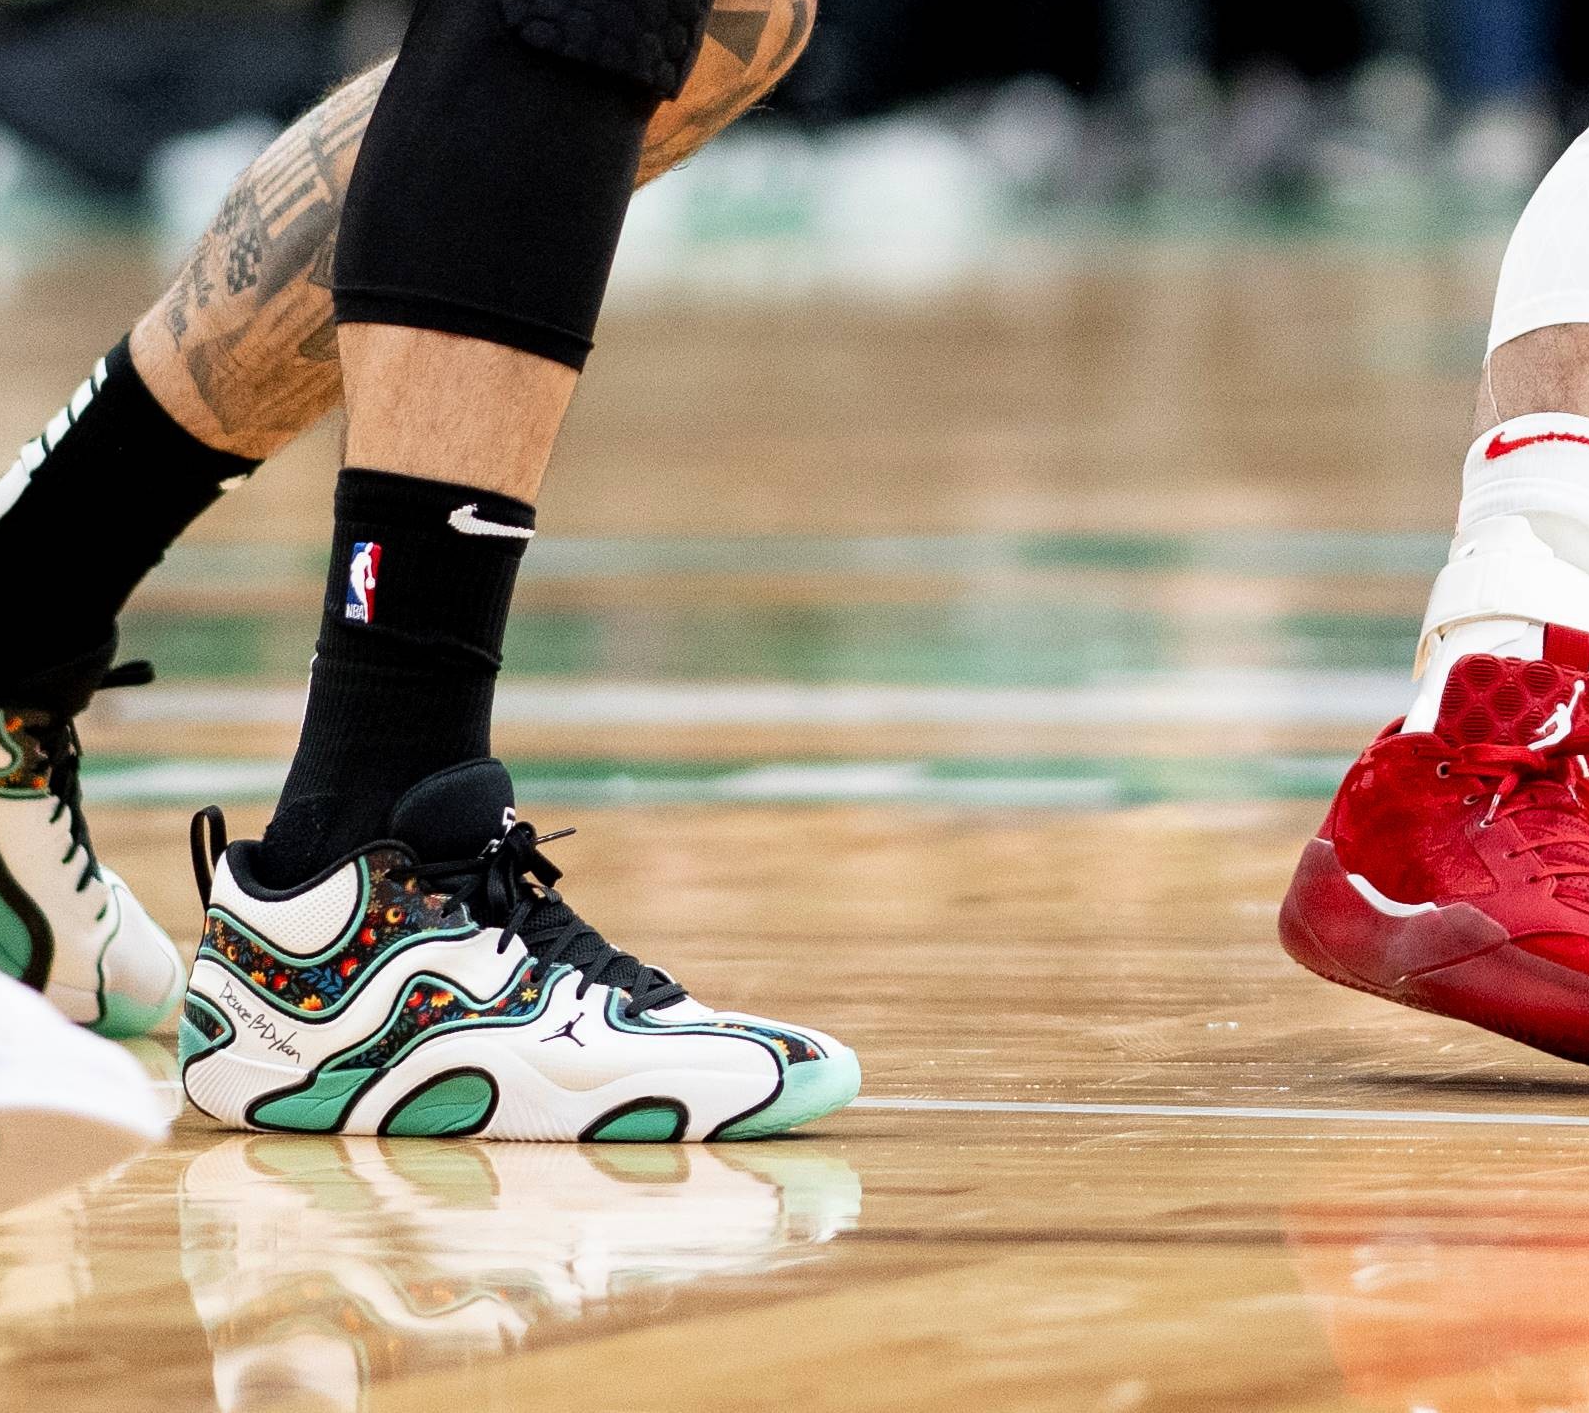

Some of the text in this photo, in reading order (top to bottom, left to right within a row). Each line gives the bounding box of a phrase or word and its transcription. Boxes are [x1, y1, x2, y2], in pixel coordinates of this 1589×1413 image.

[345, 603, 366, 620] NBA
[218, 980, 252, 1023] Deuce
[260, 1022, 301, 1064] Dylan
